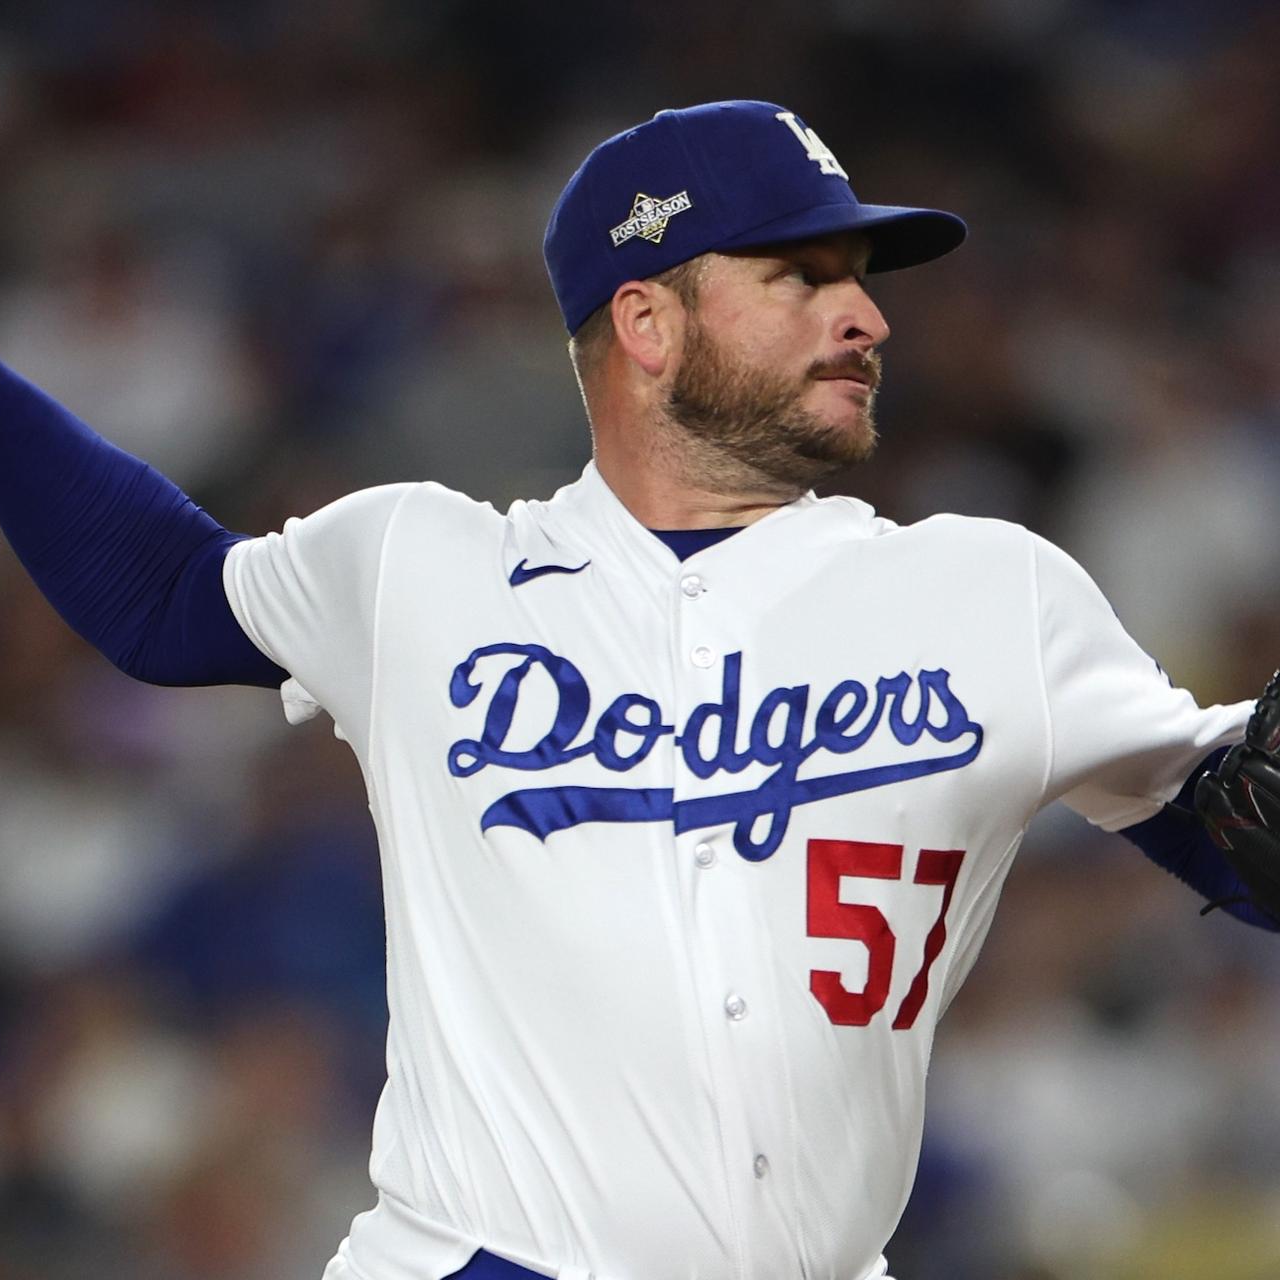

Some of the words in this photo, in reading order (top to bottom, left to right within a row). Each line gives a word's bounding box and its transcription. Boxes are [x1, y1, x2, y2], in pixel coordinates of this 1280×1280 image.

[611, 196, 691, 244] POSTSEASON
[448, 643, 983, 862] Dodgers
[806, 838, 966, 1031] 57
